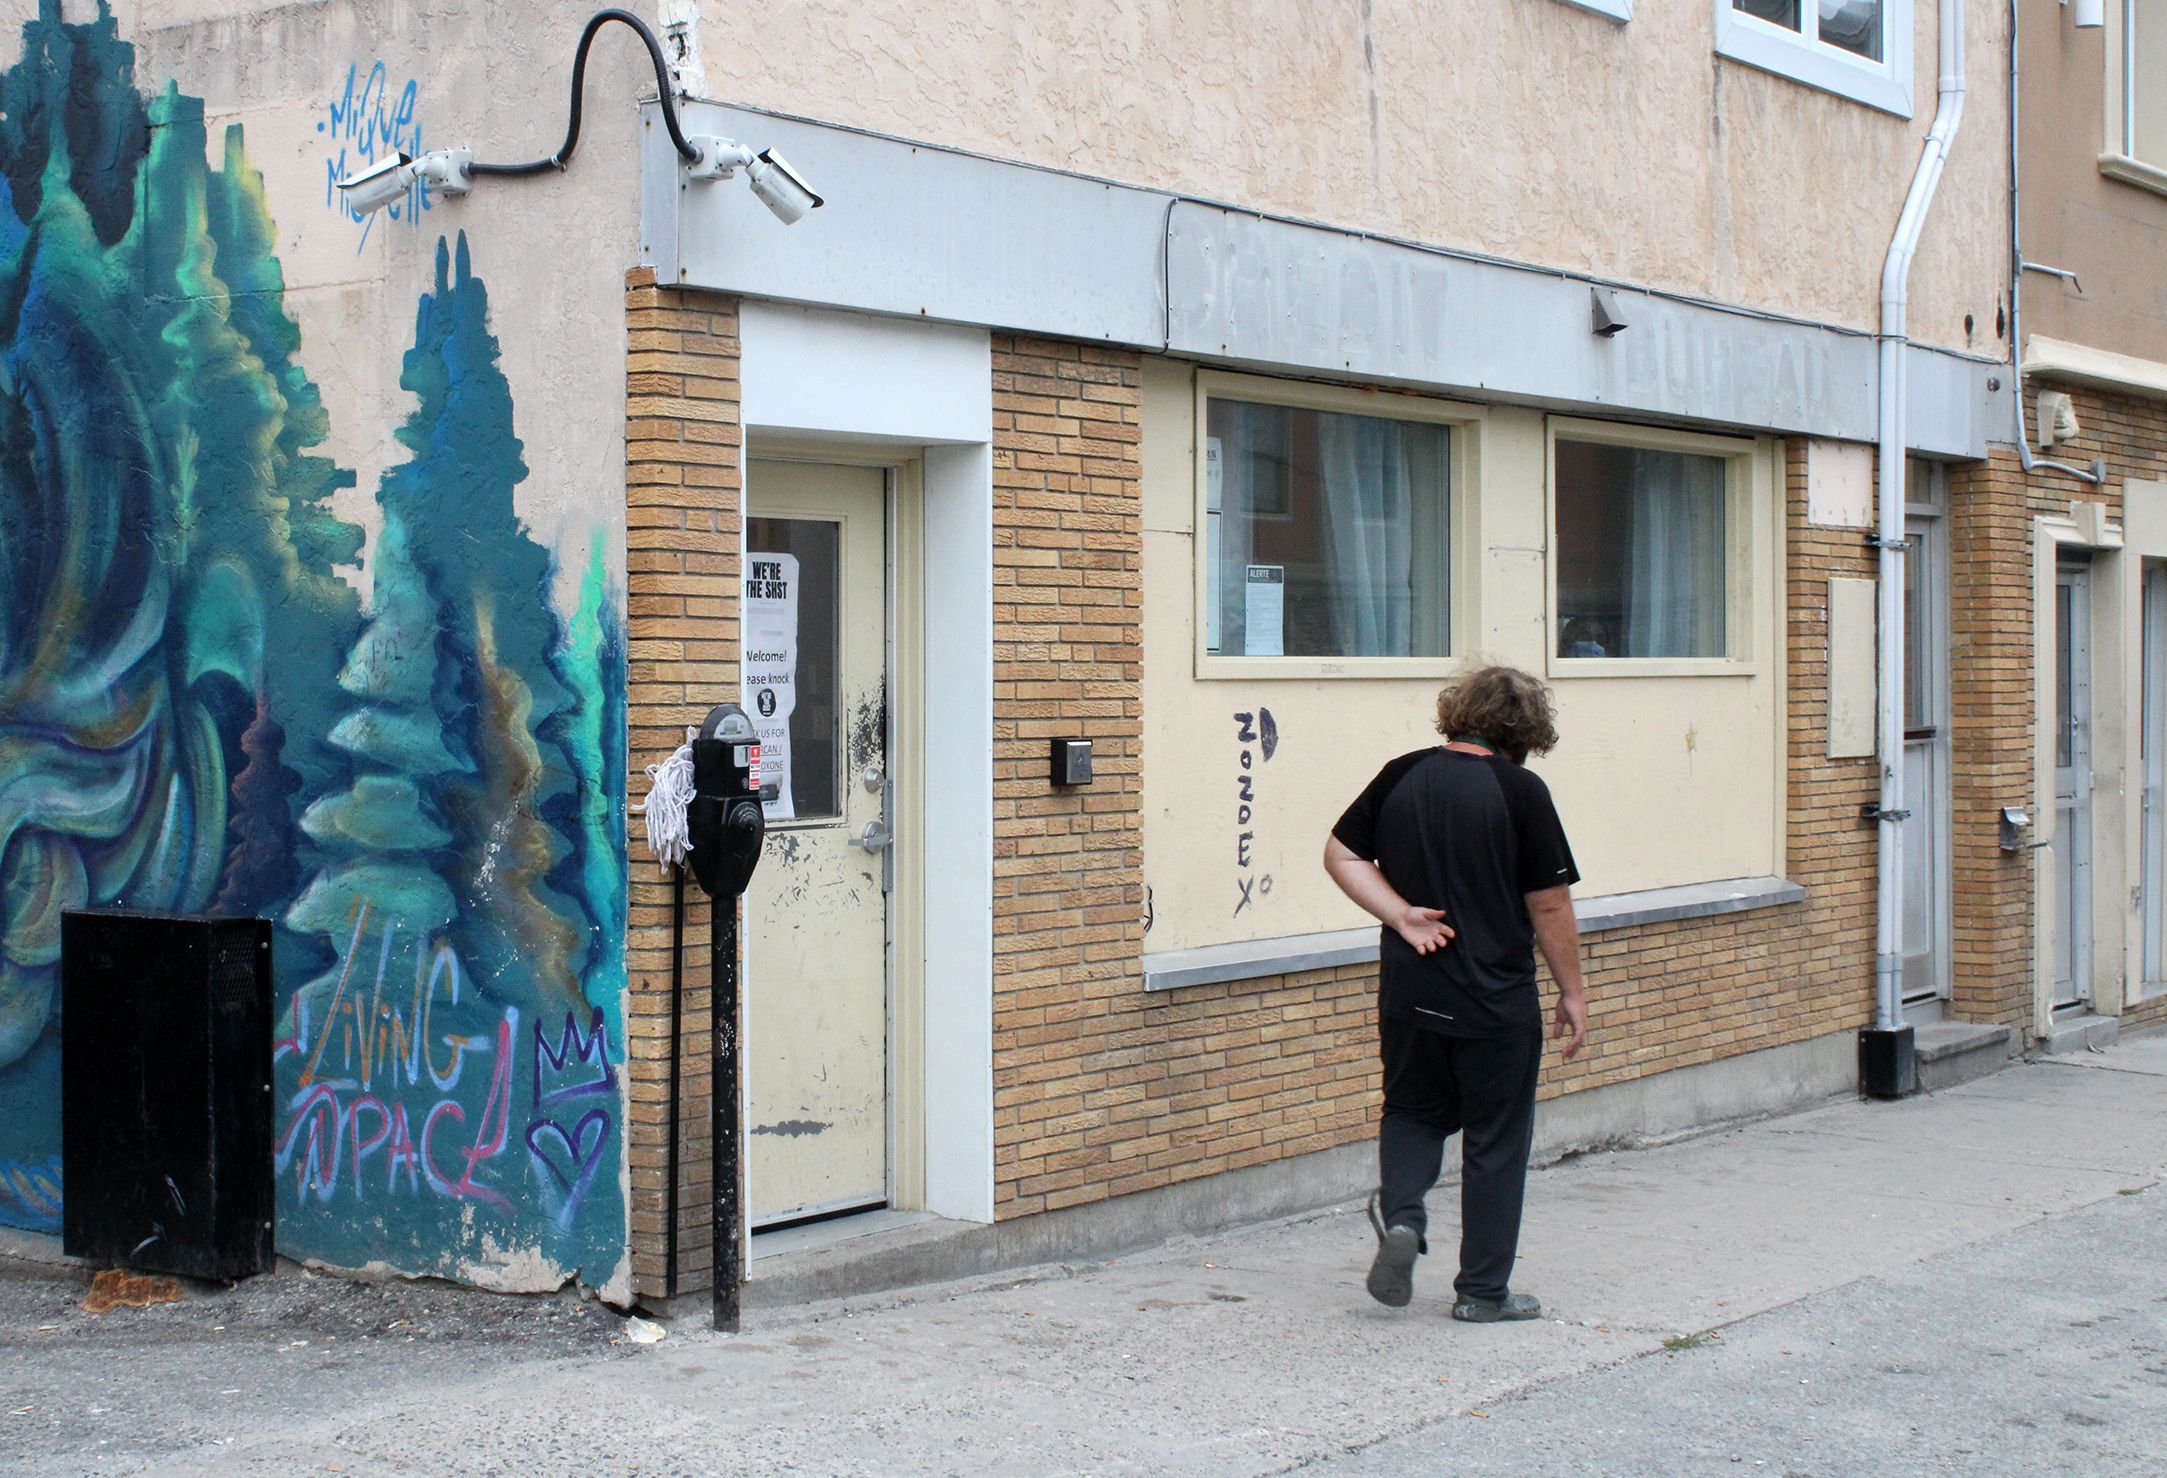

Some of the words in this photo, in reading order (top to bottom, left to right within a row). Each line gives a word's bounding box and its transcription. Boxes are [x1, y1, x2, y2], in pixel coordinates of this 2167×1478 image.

[752, 561, 782, 581] WE'RE
[1249, 569, 1270, 578] ALERTE
[768, 672, 789, 684] knock
[761, 729, 770, 738] US
[771, 728, 786, 738] FOR
